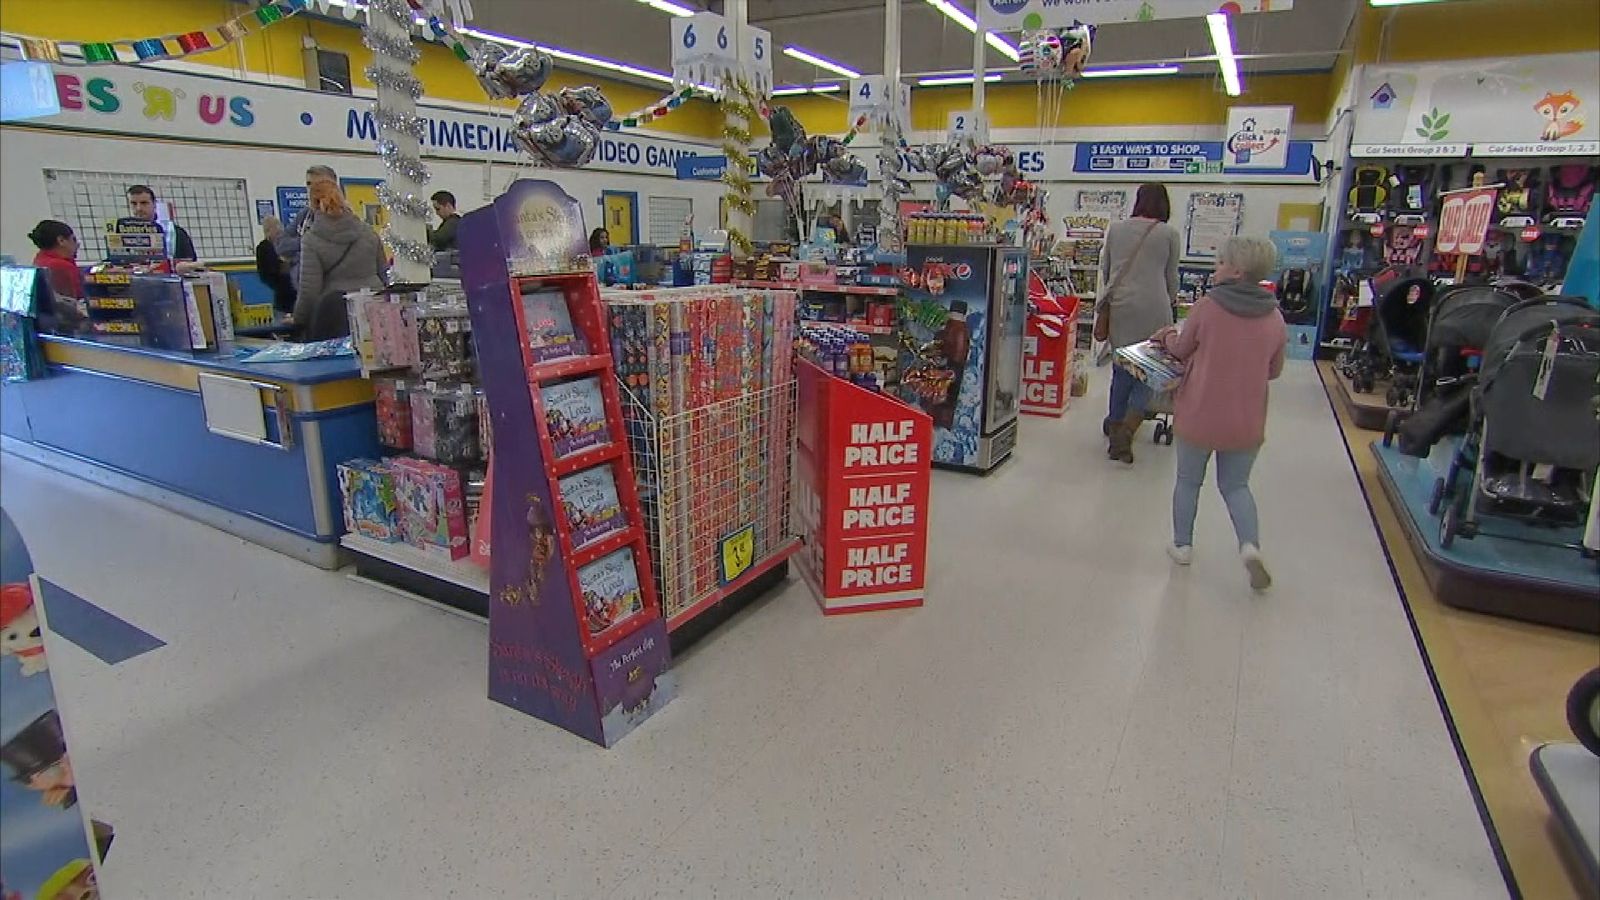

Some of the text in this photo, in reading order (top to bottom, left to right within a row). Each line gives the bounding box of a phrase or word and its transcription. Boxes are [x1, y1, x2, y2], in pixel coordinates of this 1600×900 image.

[683, 24, 697, 49] 6
[717, 26, 728, 49] 6
[754, 38, 764, 61] 5
[859, 82, 871, 100] 4
[199, 95, 255, 128] US
[956, 116, 964, 129] 2
[1091, 145, 1098, 155] 3
[1099, 145, 1123, 155] EASY
[1126, 145, 1152, 155] WAYS
[1155, 145, 1168, 155] TO
[1407, 147, 1433, 155] Group
[1489, 145, 1504, 153] Car
[1536, 145, 1566, 153] Group
[1025, 360, 1054, 381] LF
[851, 420, 914, 444] HALF
[844, 443, 919, 467] PRICE
[849, 483, 911, 507] HALF
[843, 505, 915, 529] PRICE
[848, 543, 908, 567] HALF
[841, 565, 912, 589] PRICE
